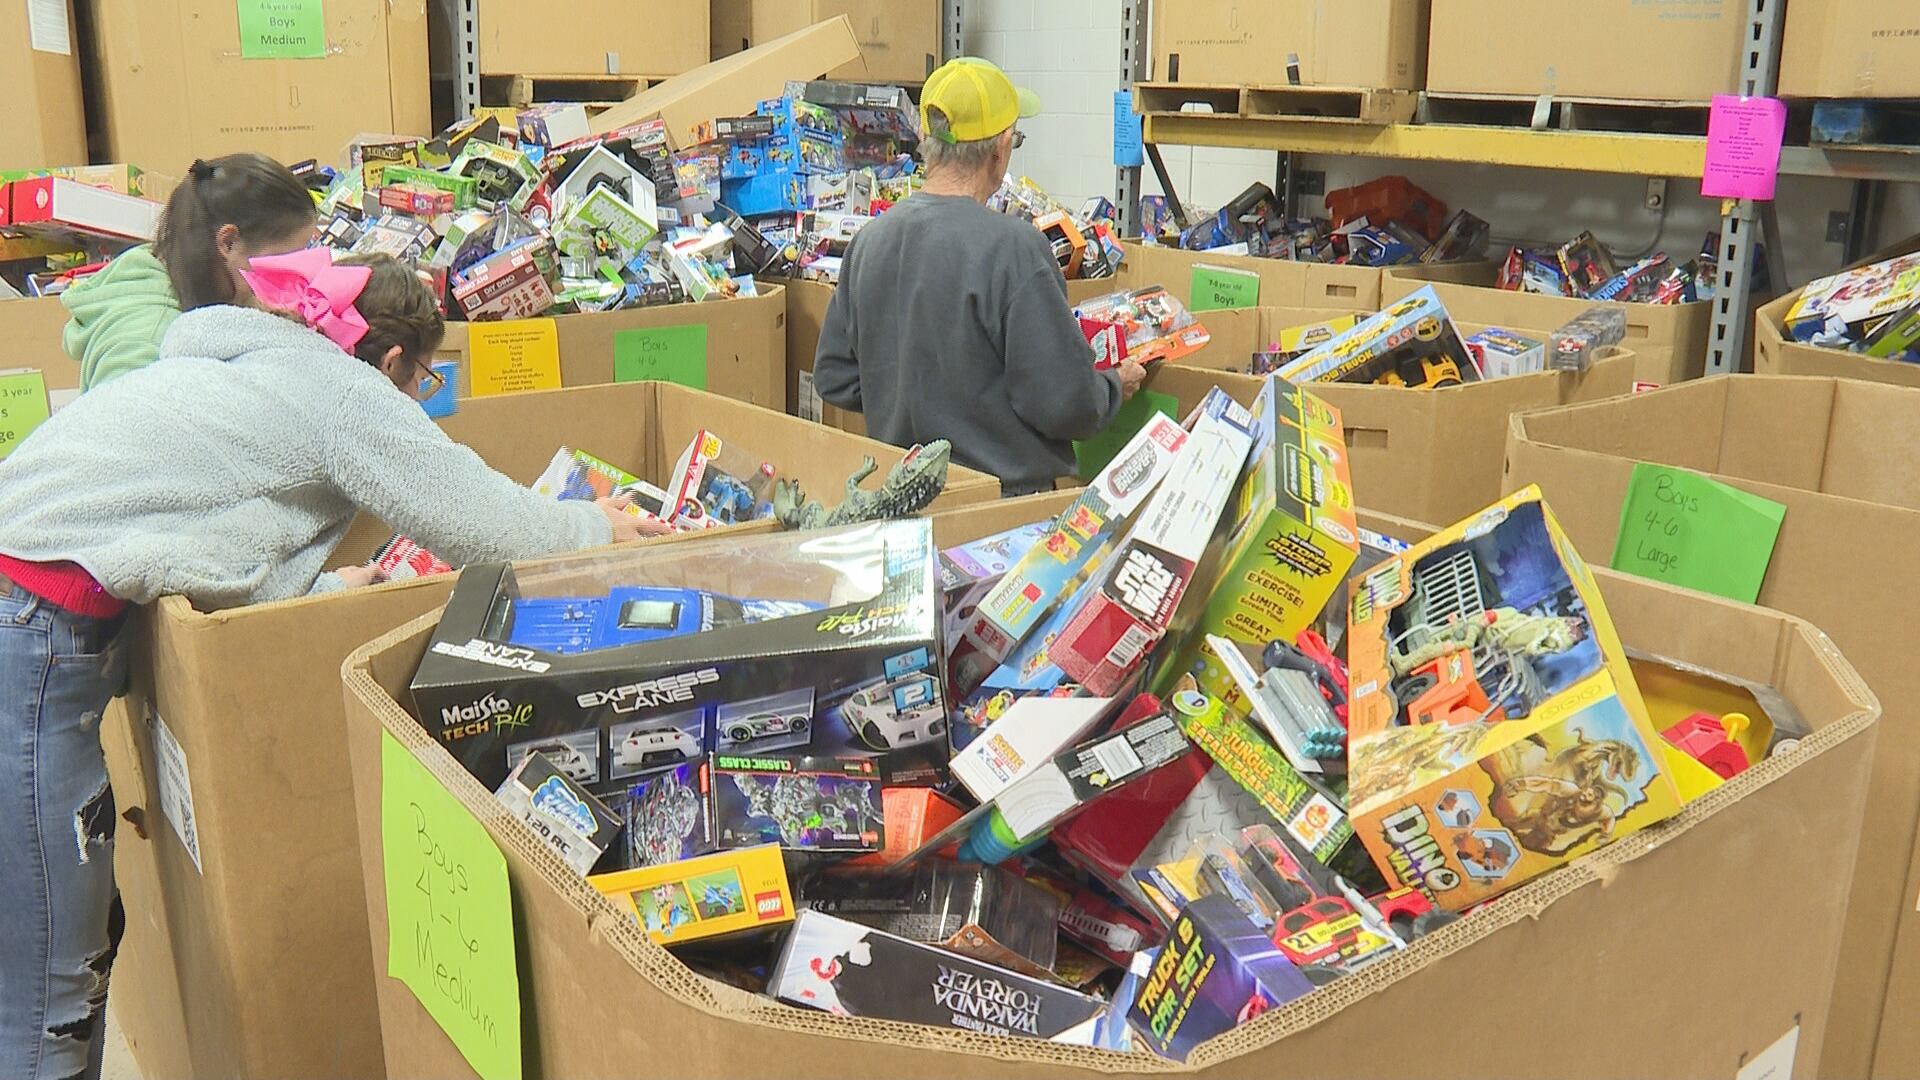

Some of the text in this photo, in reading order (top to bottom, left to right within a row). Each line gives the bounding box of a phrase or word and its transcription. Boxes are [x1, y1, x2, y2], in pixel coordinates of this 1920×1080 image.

[269, 16, 296, 28] Boys
[260, 35, 306, 45] Medium
[484, 274, 516, 295] DIY DINO
[1214, 293, 1235, 306] Boys
[640, 336, 668, 353] Boys
[1338, 350, 1375, 376] TRUCK
[11, 387, 32, 399] year
[1655, 474, 1698, 512] Boys
[1644, 510, 1679, 536] 4-6
[1266, 540, 1331, 575] ROCKET
[1277, 536, 1333, 568] STOMP
[1636, 539, 1679, 574] Large
[1113, 548, 1155, 604] STAR
[1131, 559, 1175, 615] WARS
[1246, 572, 1304, 608] EXERCISE!
[1240, 597, 1264, 614] Screen
[1249, 592, 1285, 616] LIMITS
[1225, 619, 1256, 637] Outdoor
[1235, 612, 1271, 637] GREAT
[431, 641, 552, 674] EXPRESS
[464, 638, 535, 661] LANE
[576, 667, 720, 709] EXPRESS
[612, 685, 695, 715] LANE
[904, 686, 925, 704] 2
[440, 720, 490, 741] TECH
[719, 756, 793, 771] CLASSIC CLASS
[992, 733, 1025, 770] SONIC
[1223, 731, 1274, 781] JUNGLE
[1190, 720, 1233, 763] SAFARI
[1232, 761, 1265, 792] PLAY
[1264, 790, 1291, 818] SET
[410, 801, 469, 894] Boys
[524, 812, 572, 855] 1:20 RC
[1382, 804, 1461, 892] DINO
[415, 867, 479, 961] 4-6
[758, 897, 780, 913] LEGO
[1287, 931, 1317, 949] 27
[415, 920, 499, 1049] Medium
[937, 964, 1043, 1016] FOREVER
[1137, 939, 1181, 1017] TRUCK
[1150, 934, 1205, 1039] CAR SET
[932, 983, 1039, 1036] WAKANDA
